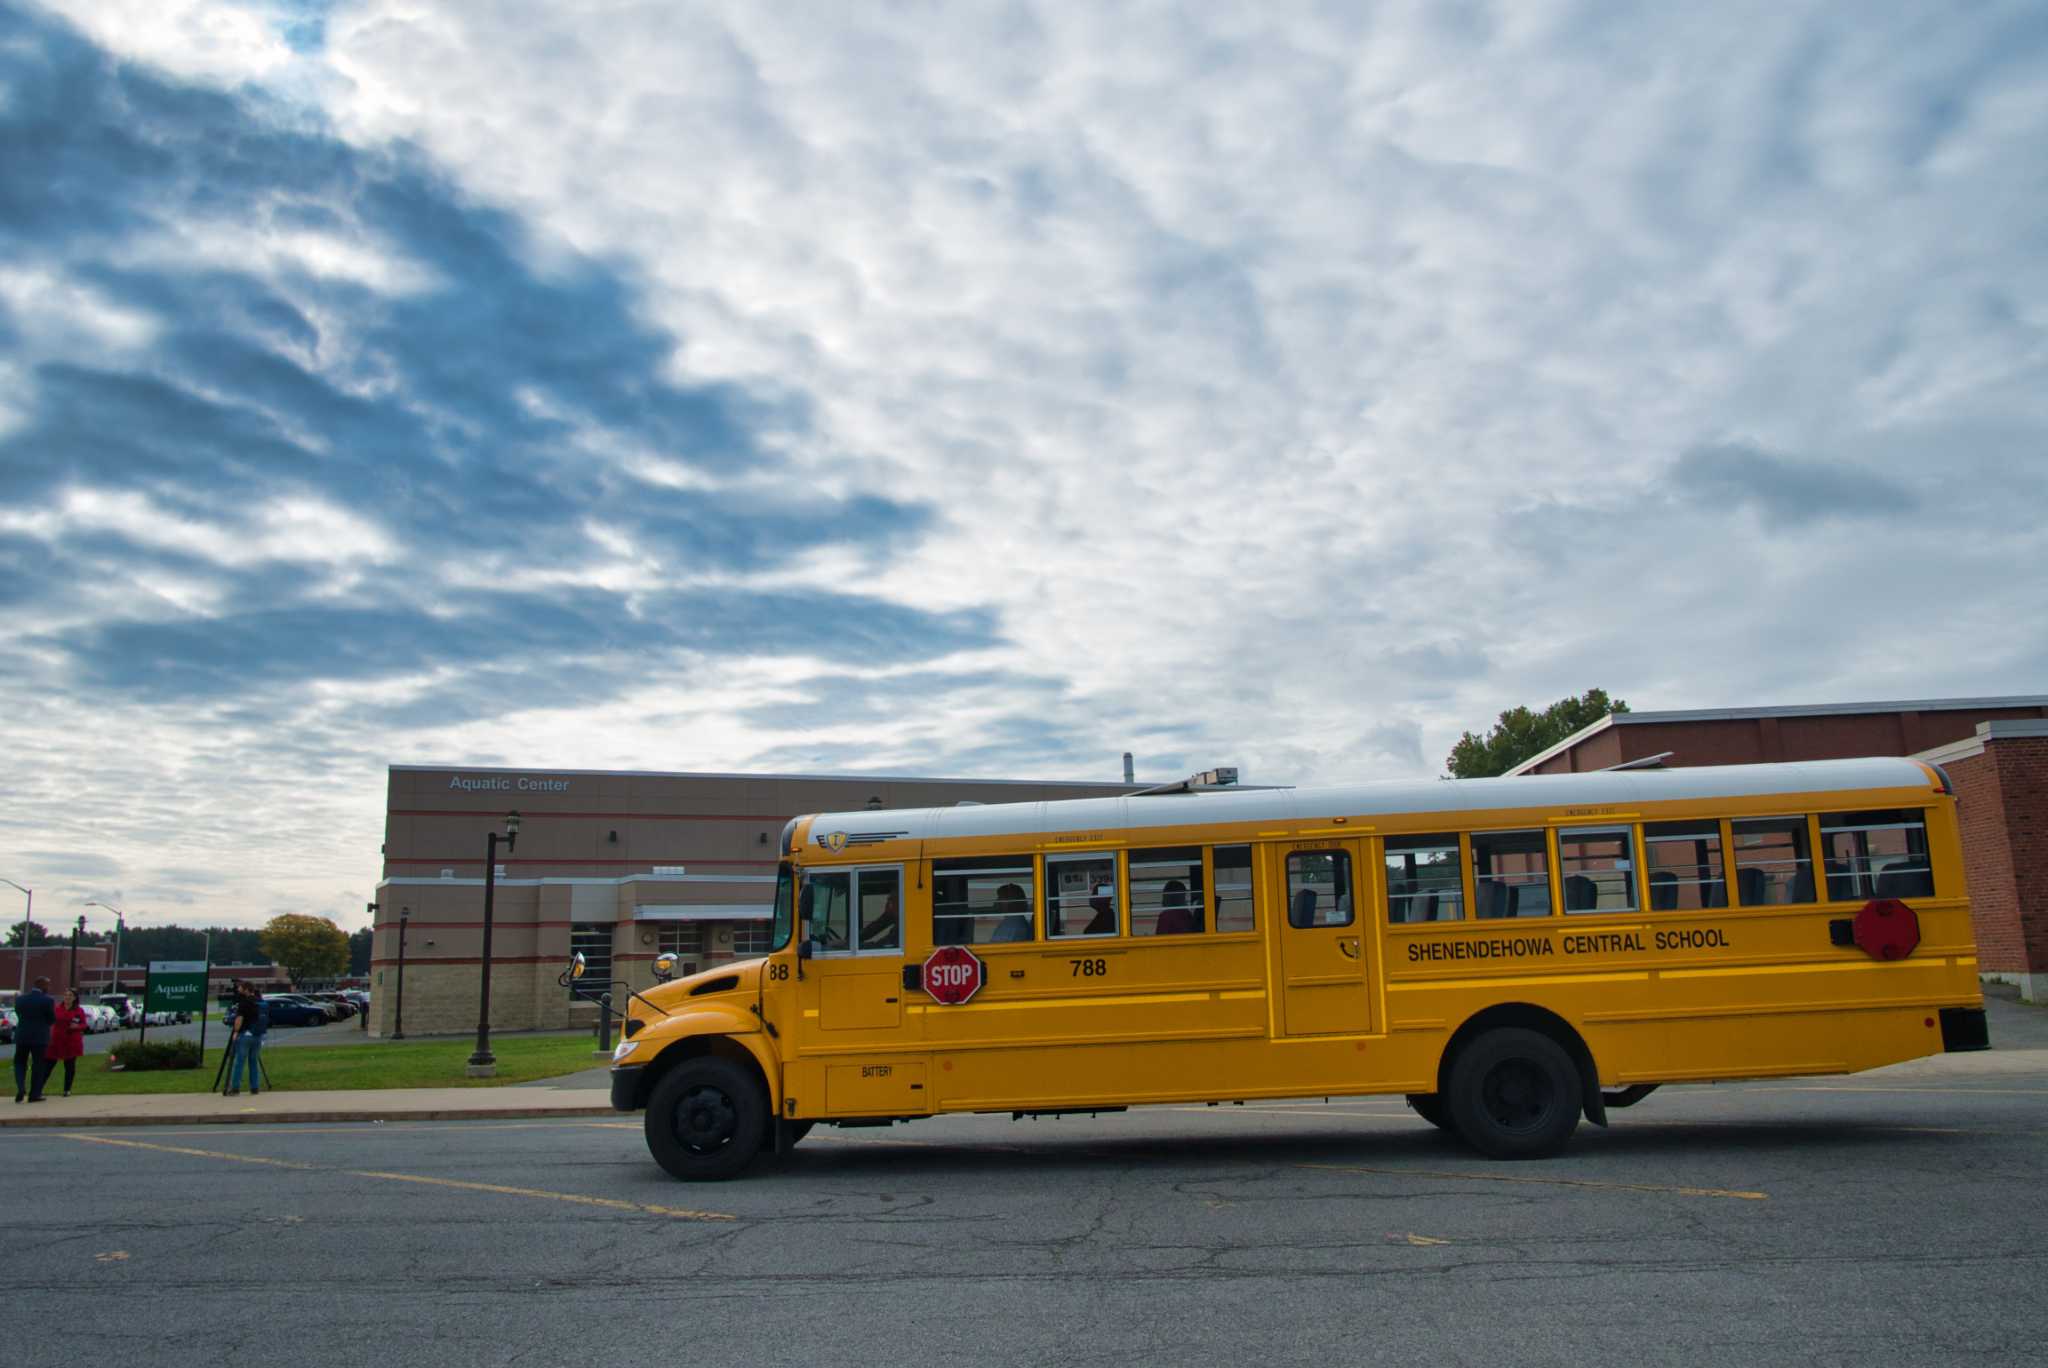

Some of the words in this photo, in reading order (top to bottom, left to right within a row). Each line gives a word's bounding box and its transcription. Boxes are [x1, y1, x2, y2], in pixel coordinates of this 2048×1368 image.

[449, 776, 510, 791] Aquatic
[518, 777, 568, 791] Center
[1408, 938, 1554, 961] SHENENDEHOWA
[1563, 933, 1646, 954] CENTRAL
[1655, 929, 1729, 949] SCHOOL
[931, 964, 973, 987] STOP
[1070, 959, 1106, 976] 788
[154, 984, 199, 995] Aquatic
[862, 1066, 892, 1077] BATTERY
